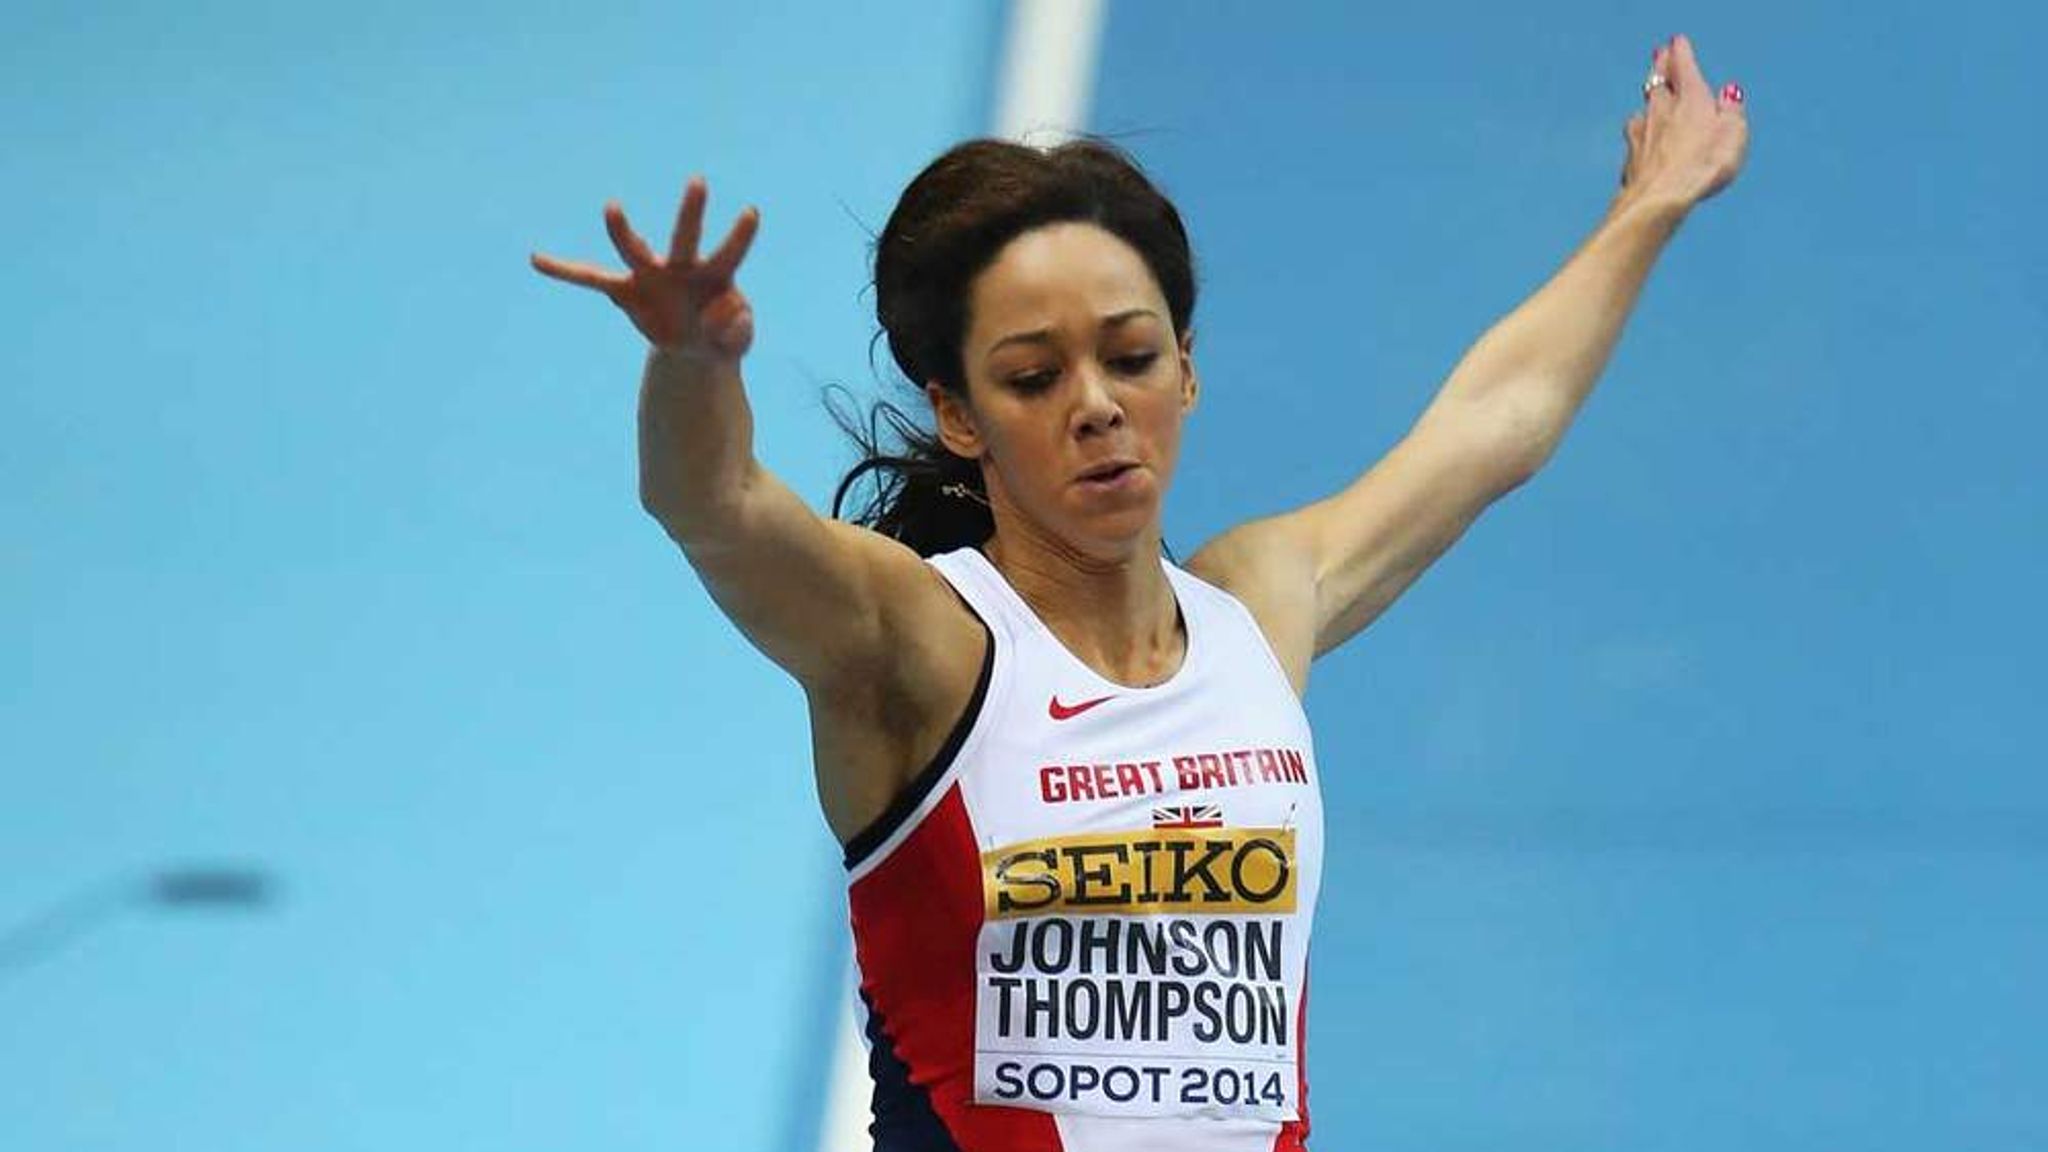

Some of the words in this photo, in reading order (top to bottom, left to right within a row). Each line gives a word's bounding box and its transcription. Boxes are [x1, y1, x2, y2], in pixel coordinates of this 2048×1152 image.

[1040, 762, 1163, 804] GREAT
[1172, 750, 1308, 791] BRITAIN
[996, 838, 1290, 912] SEIKO
[989, 917, 1283, 981] JOHNSON
[989, 977, 1287, 1046] THOMPSON
[994, 1062, 1170, 1102] SOPOT
[1180, 1067, 1285, 1107] 2014
